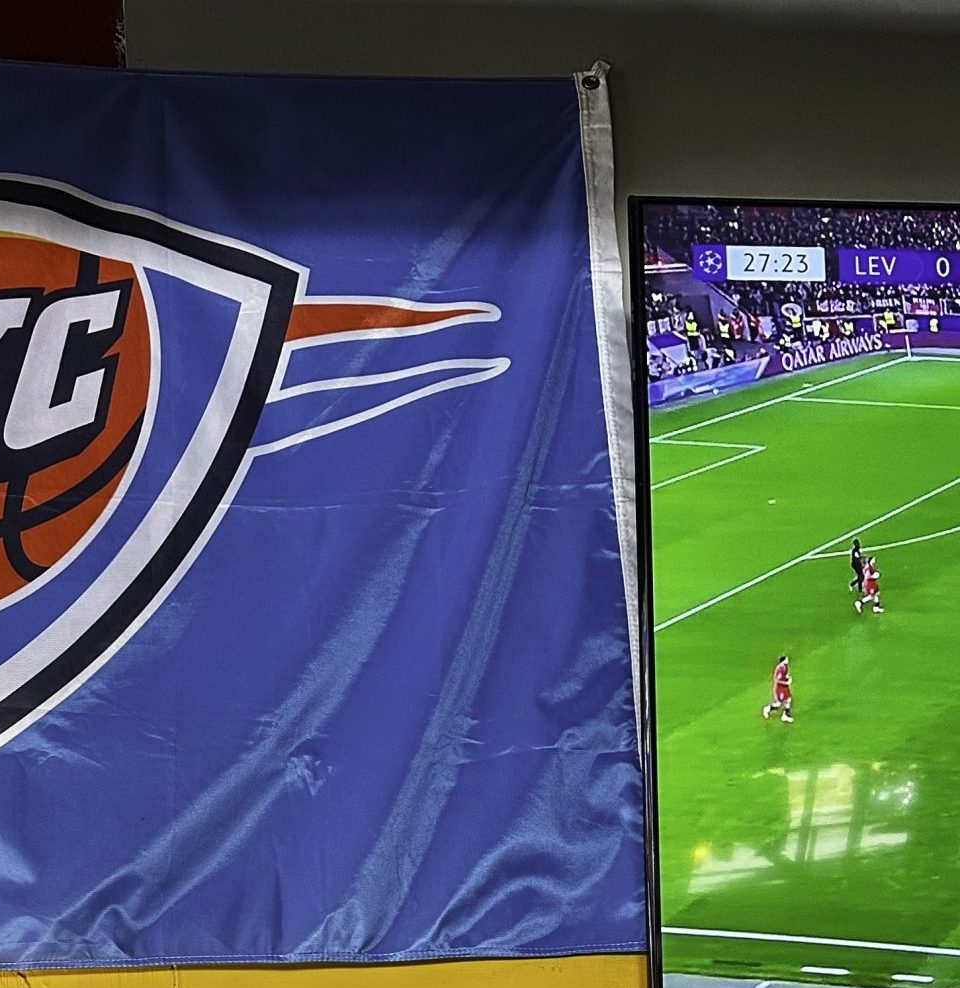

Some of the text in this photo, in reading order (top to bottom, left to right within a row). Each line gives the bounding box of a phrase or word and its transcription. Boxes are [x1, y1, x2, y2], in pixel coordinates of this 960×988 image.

[742, 252, 951, 278] 27:23 LEV 0
[782, 331, 883, 371] QATAR AIRWAYS
